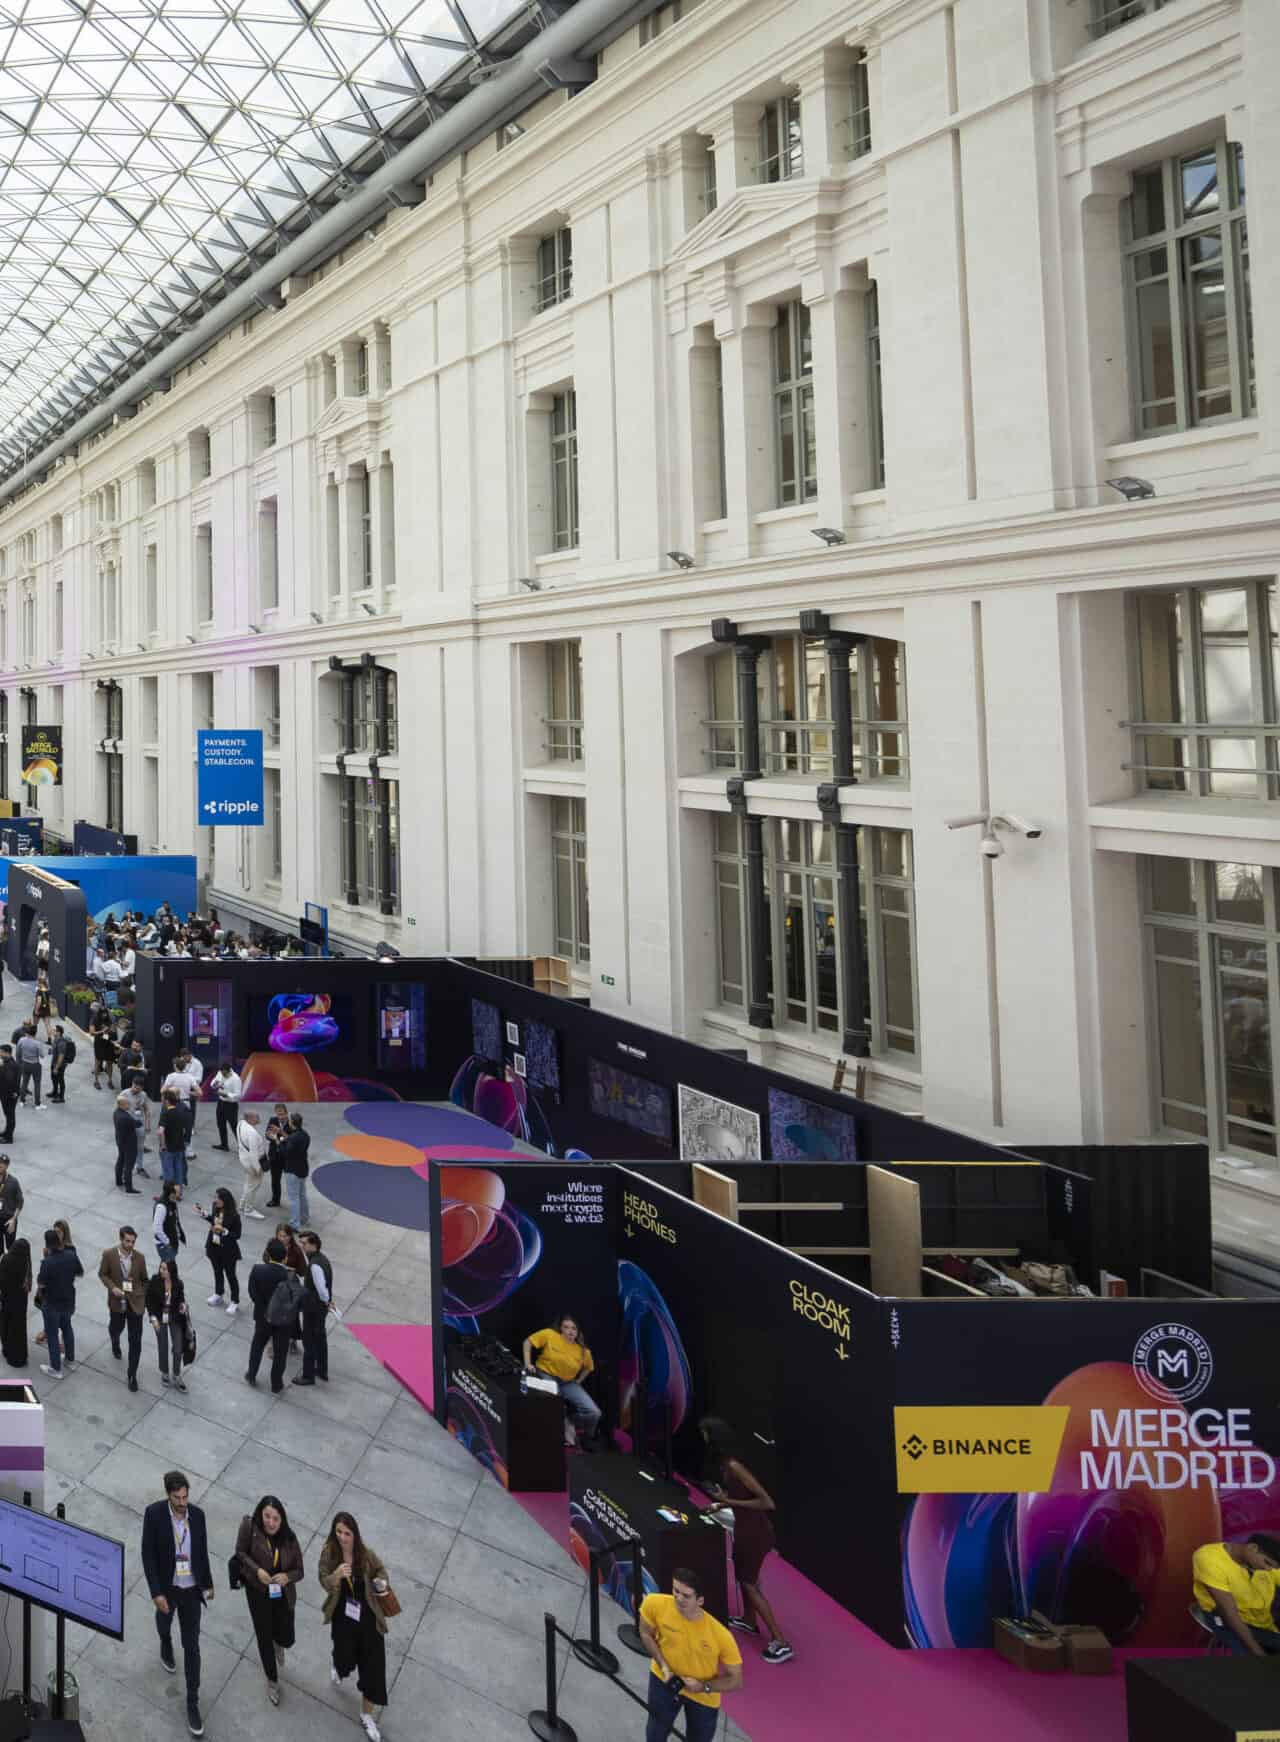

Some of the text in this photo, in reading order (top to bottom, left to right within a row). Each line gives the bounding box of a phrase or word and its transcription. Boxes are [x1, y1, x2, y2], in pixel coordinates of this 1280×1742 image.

[218, 800, 260, 814] ripple
[546, 1192, 604, 1203] institutions
[568, 1182, 604, 1192] Where
[541, 1203, 604, 1214] meet crypto
[624, 1190, 658, 1218] HEAD
[624, 1204, 677, 1244] PHONES
[789, 1279, 851, 1324] CLOAK
[792, 1296, 851, 1341] ROOM
[1136, 1326, 1208, 1360] MERGE MADRID
[1089, 1408, 1252, 1448] MERGE
[932, 1439, 1032, 1456] BINANCE
[1080, 1450, 1276, 1490] MADRID
